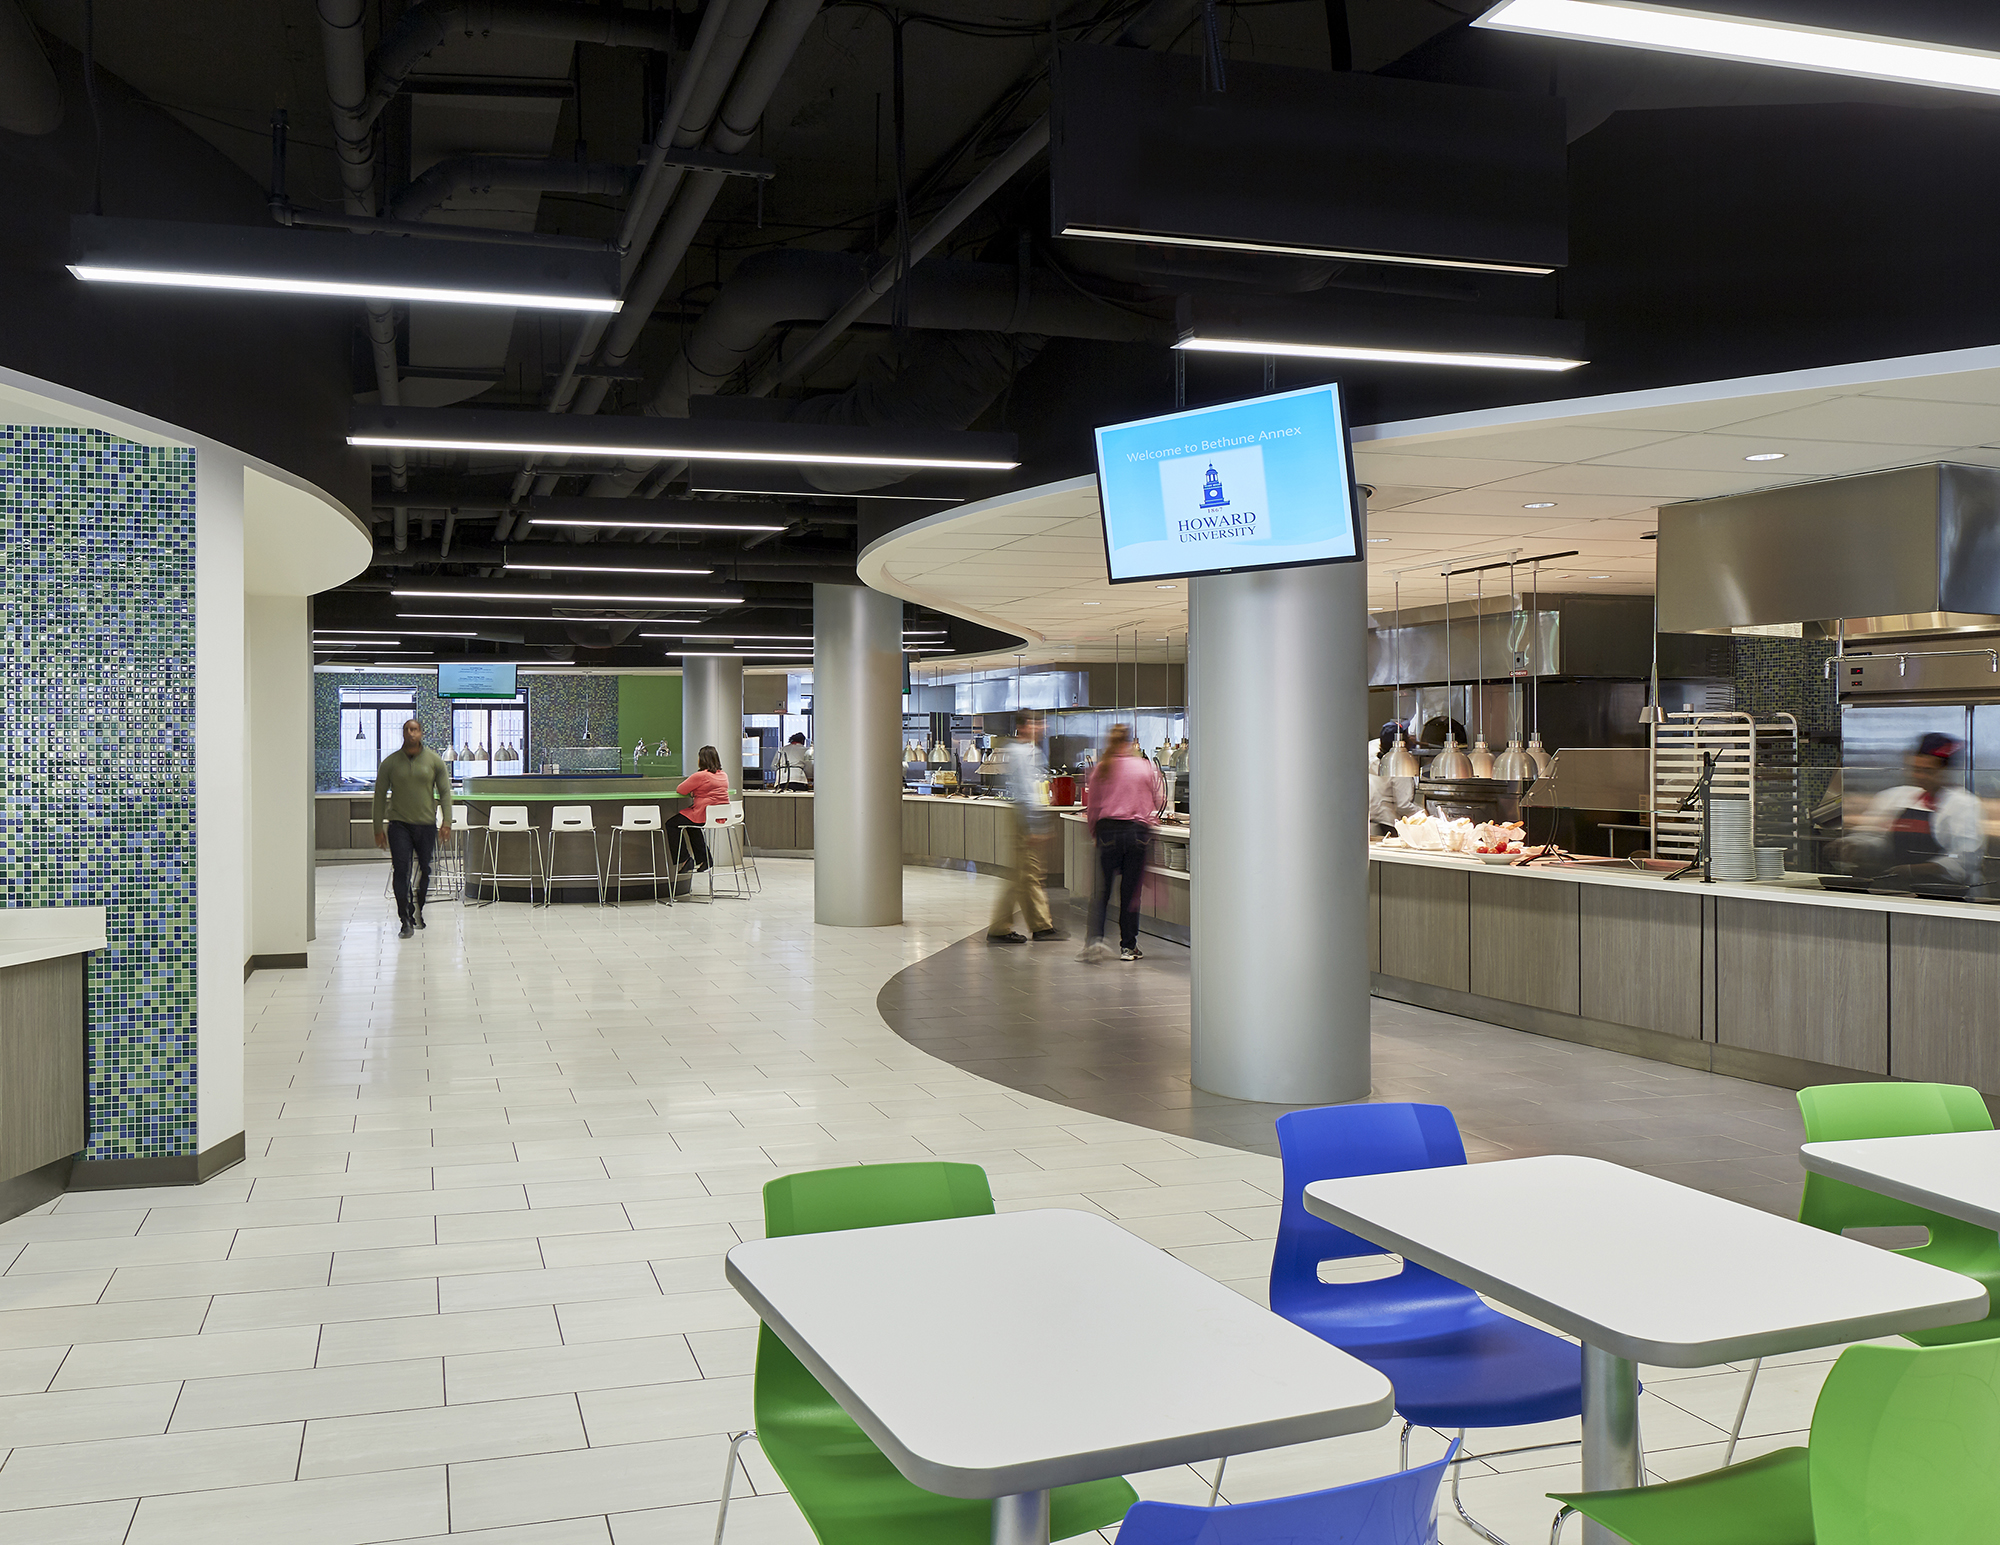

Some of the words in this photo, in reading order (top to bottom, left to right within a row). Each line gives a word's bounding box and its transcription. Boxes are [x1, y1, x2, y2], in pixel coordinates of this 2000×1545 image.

[1126, 446, 1182, 462] Welcome
[1184, 444, 1198, 453] to
[1201, 434, 1255, 451] Bethune
[1258, 426, 1302, 441] Annex
[1178, 511, 1256, 532] HOWARD
[1179, 526, 1256, 543] UNIVERSITY
